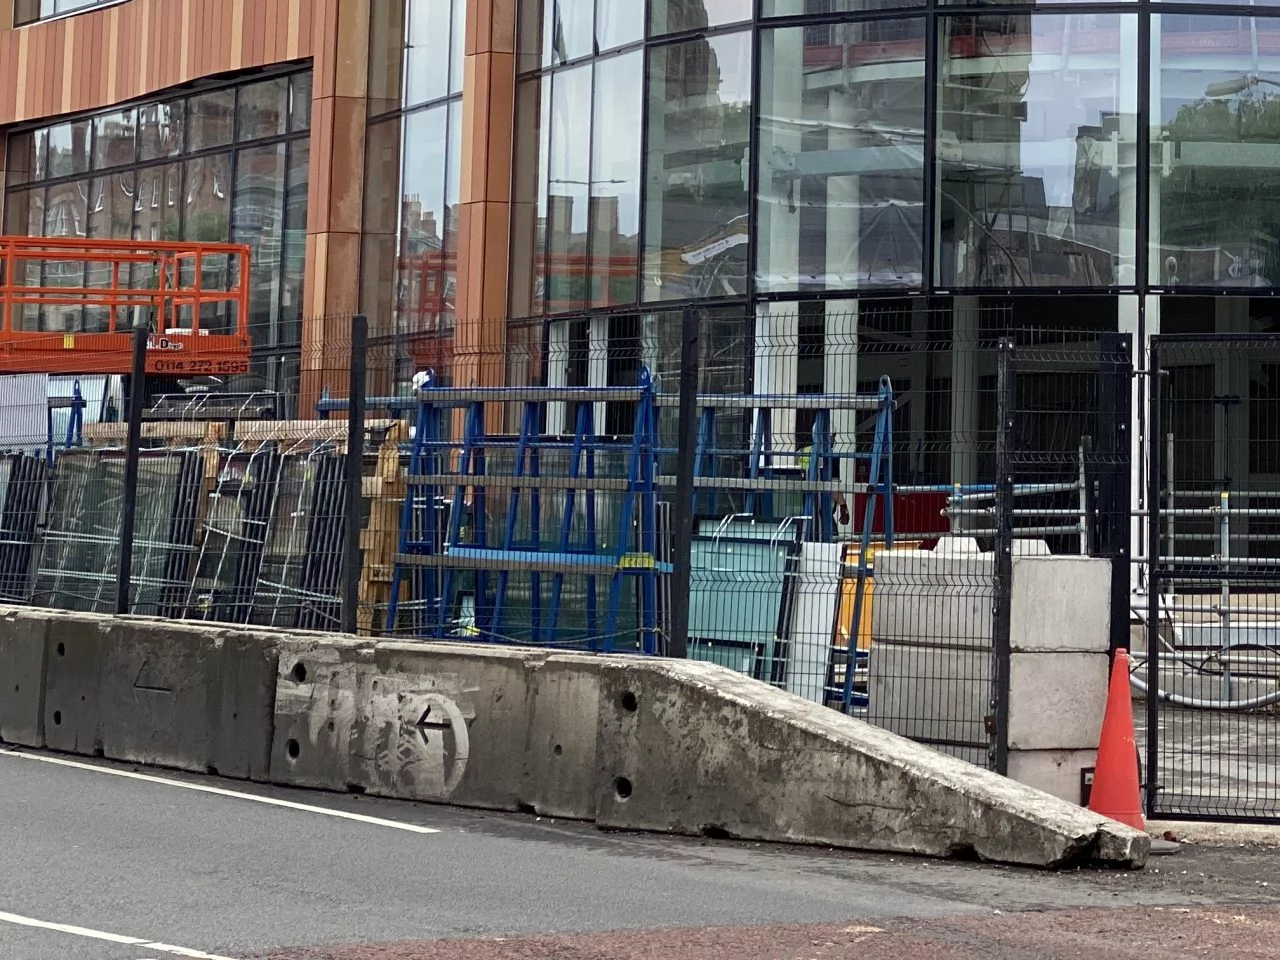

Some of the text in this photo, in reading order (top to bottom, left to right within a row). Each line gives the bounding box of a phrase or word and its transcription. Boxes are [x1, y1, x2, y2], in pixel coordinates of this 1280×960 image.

[155, 360, 248, 373] 0114 272 1595
